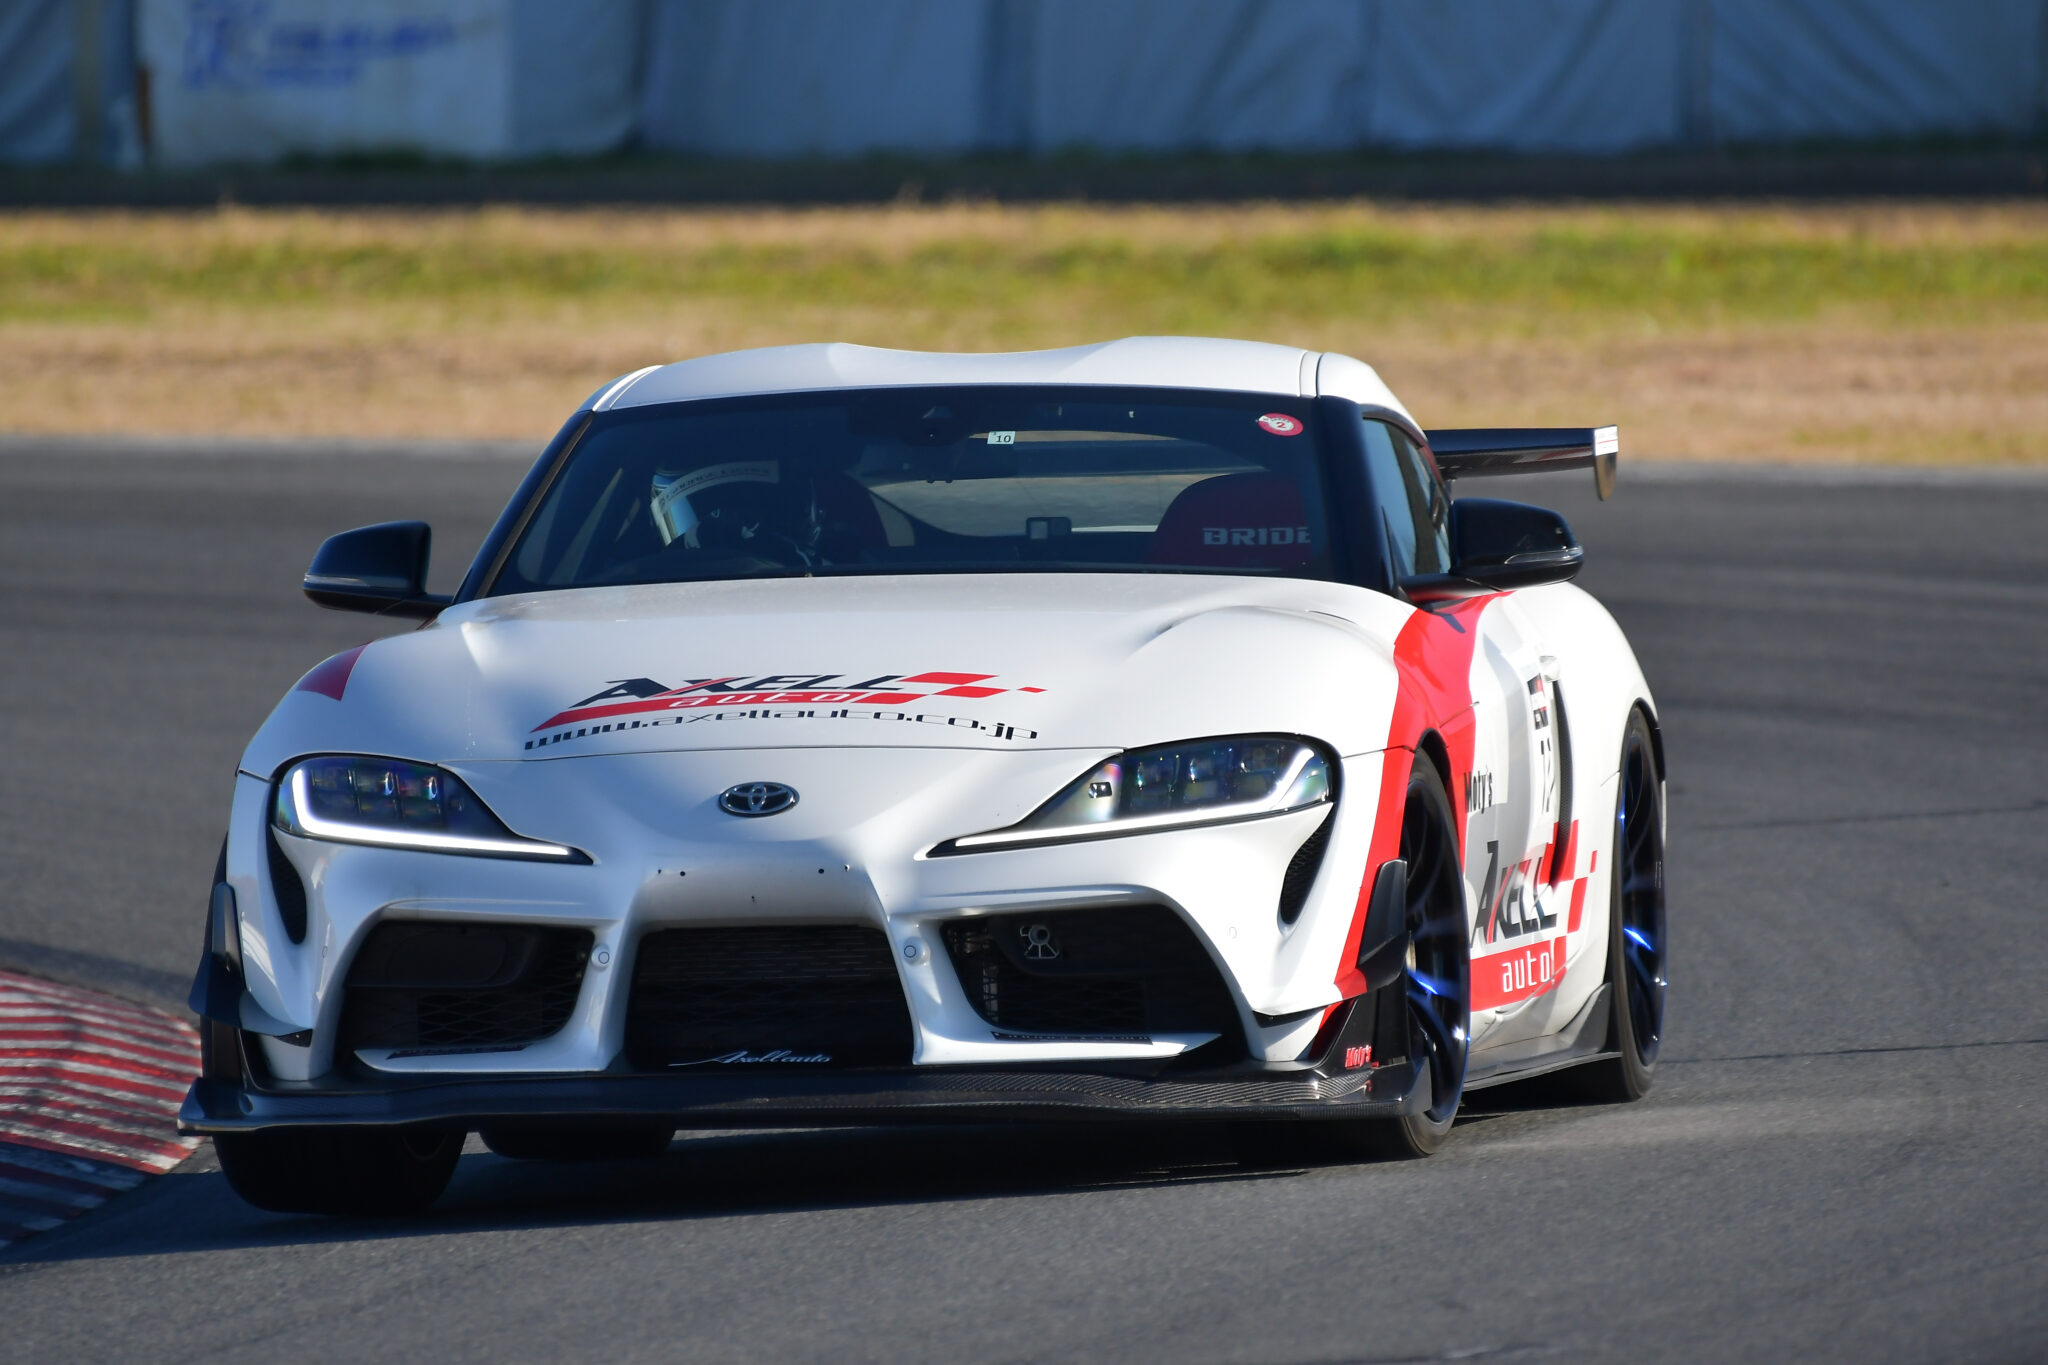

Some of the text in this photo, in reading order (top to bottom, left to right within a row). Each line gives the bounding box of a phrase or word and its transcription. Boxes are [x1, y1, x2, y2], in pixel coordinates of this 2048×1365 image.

[995, 435, 1011, 443] 10
[1202, 526, 1311, 545] BRIDE
[568, 674, 906, 709] AXELL
[669, 692, 850, 708] auto
[524, 709, 1038, 751] www.axellauto.co.jp
[1501, 950, 1551, 993] auto
